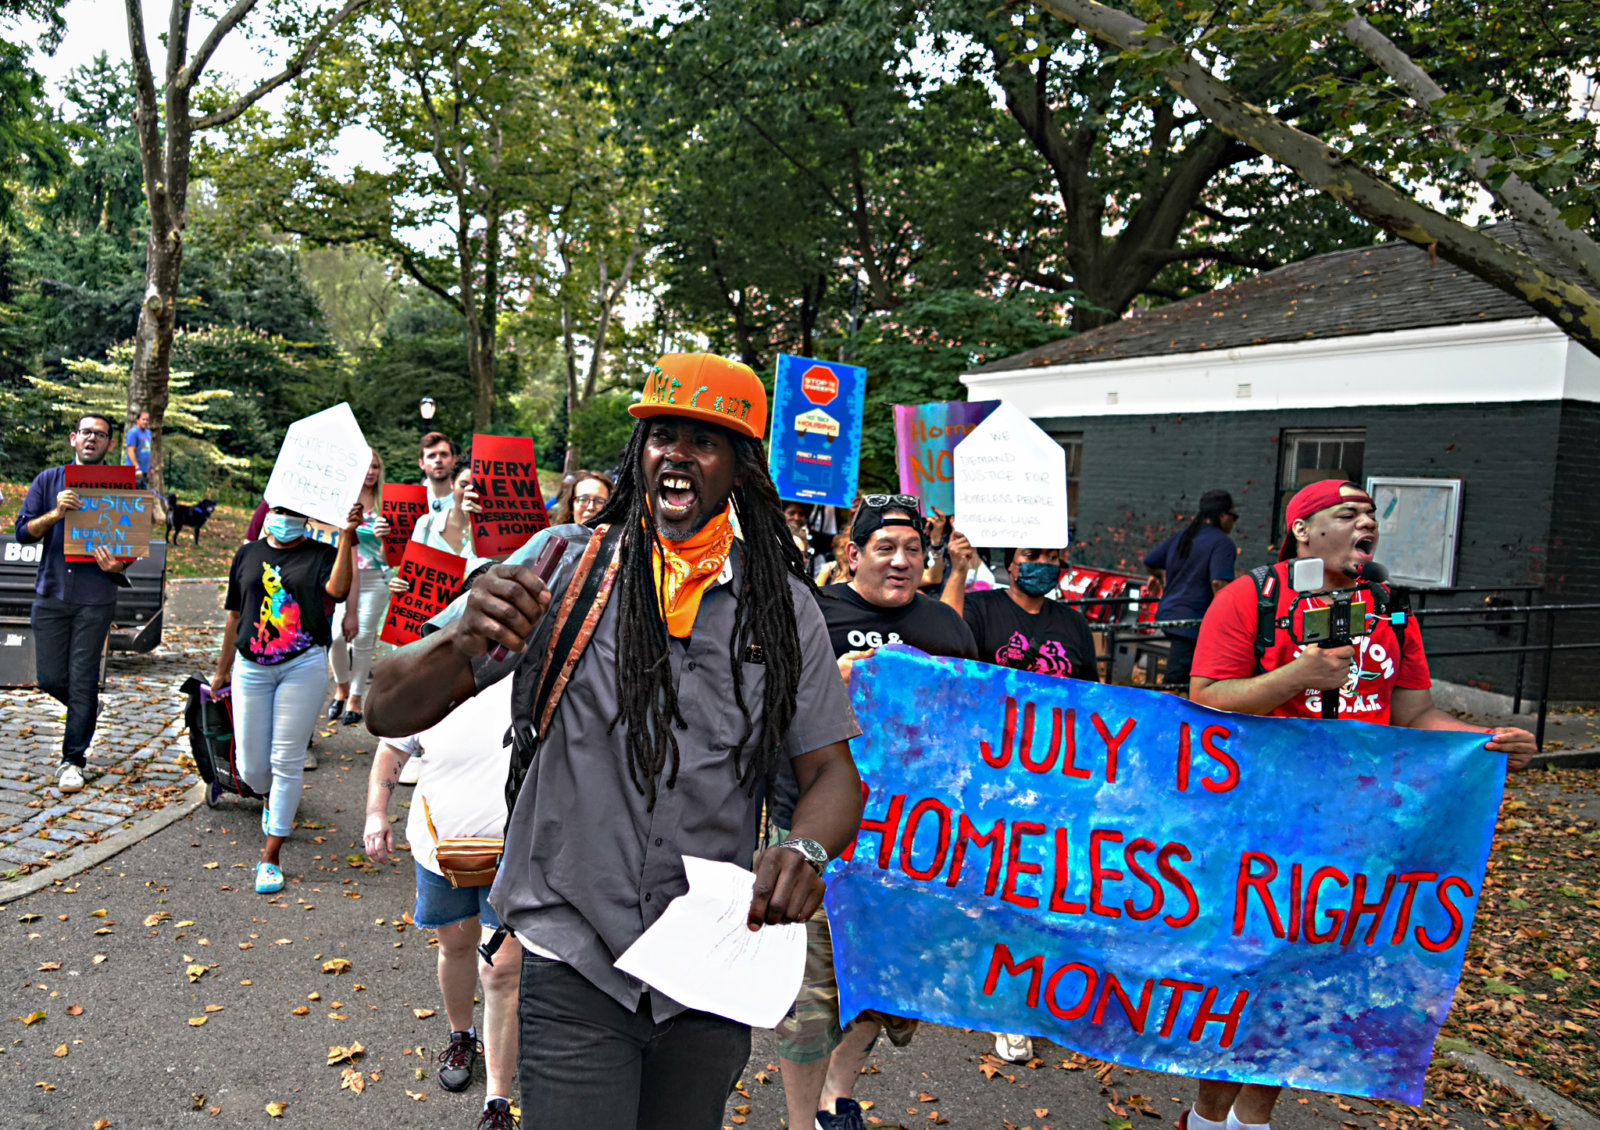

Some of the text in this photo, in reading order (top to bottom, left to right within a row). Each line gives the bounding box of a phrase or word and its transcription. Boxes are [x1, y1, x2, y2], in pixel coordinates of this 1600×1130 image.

[797, 420, 837, 431] HOUSING
[989, 430, 1011, 441] WE
[960, 452, 1016, 466] DEMAND
[473, 459, 532, 477] EVERY
[960, 469, 1050, 485] JUSTICE FOR
[472, 477, 536, 498] NEW
[383, 500, 426, 513] EVERY
[476, 499, 542, 510] ORKER
[98, 512, 132, 528] IS A
[474, 511, 545, 524] DESERVES
[71, 525, 127, 542] HUMAN
[477, 525, 489, 538] A
[388, 545, 396, 554] A
[402, 560, 460, 588] EVERY
[395, 592, 443, 616] YORKE
[387, 615, 397, 627] A
[847, 630, 883, 648] OG
[979, 696, 1241, 794] JULY IS
[840, 781, 1200, 929] HOMELESS
[1232, 851, 1474, 953] RIGHTS
[982, 943, 1249, 1048] MONTH
